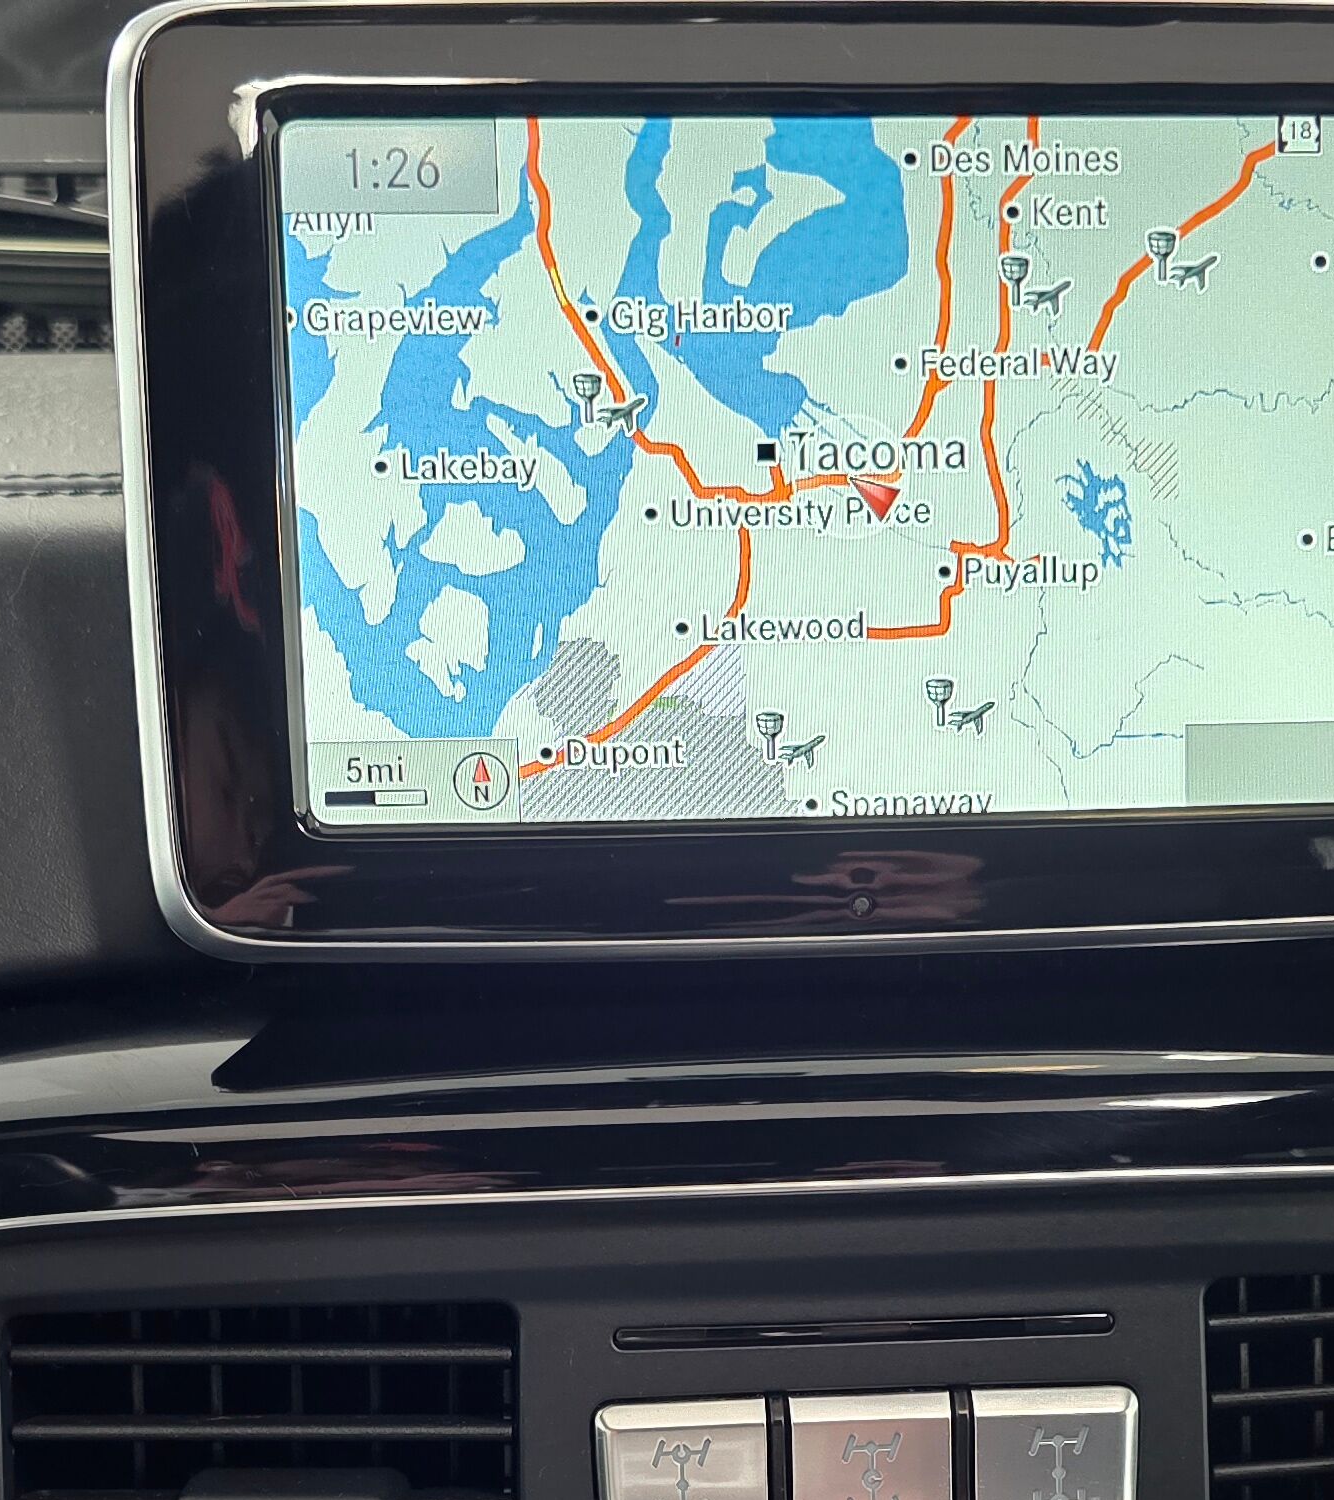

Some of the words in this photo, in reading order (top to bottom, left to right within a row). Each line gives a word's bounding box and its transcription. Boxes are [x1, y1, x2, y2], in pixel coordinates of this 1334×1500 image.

[1289, 122, 1312, 142] 18
[346, 147, 442, 190] 1:26
[931, 145, 990, 174] Des
[1003, 144, 1120, 174] Moines
[1032, 199, 1107, 227] Kent
[308, 301, 485, 335] Grapeview
[611, 300, 666, 336] Gig
[676, 301, 791, 331] Harbor
[922, 349, 1040, 376] Federal
[1051, 350, 1117, 380] Way
[790, 432, 967, 471] Tacoma
[402, 453, 538, 488] Lakebay
[671, 497, 832, 531] University
[964, 557, 1099, 591] Puyallup
[703, 612, 865, 641] Lakewood
[347, 756, 404, 785] 5mi
[567, 740, 685, 774] Dupont
[474, 786, 489, 802] N
